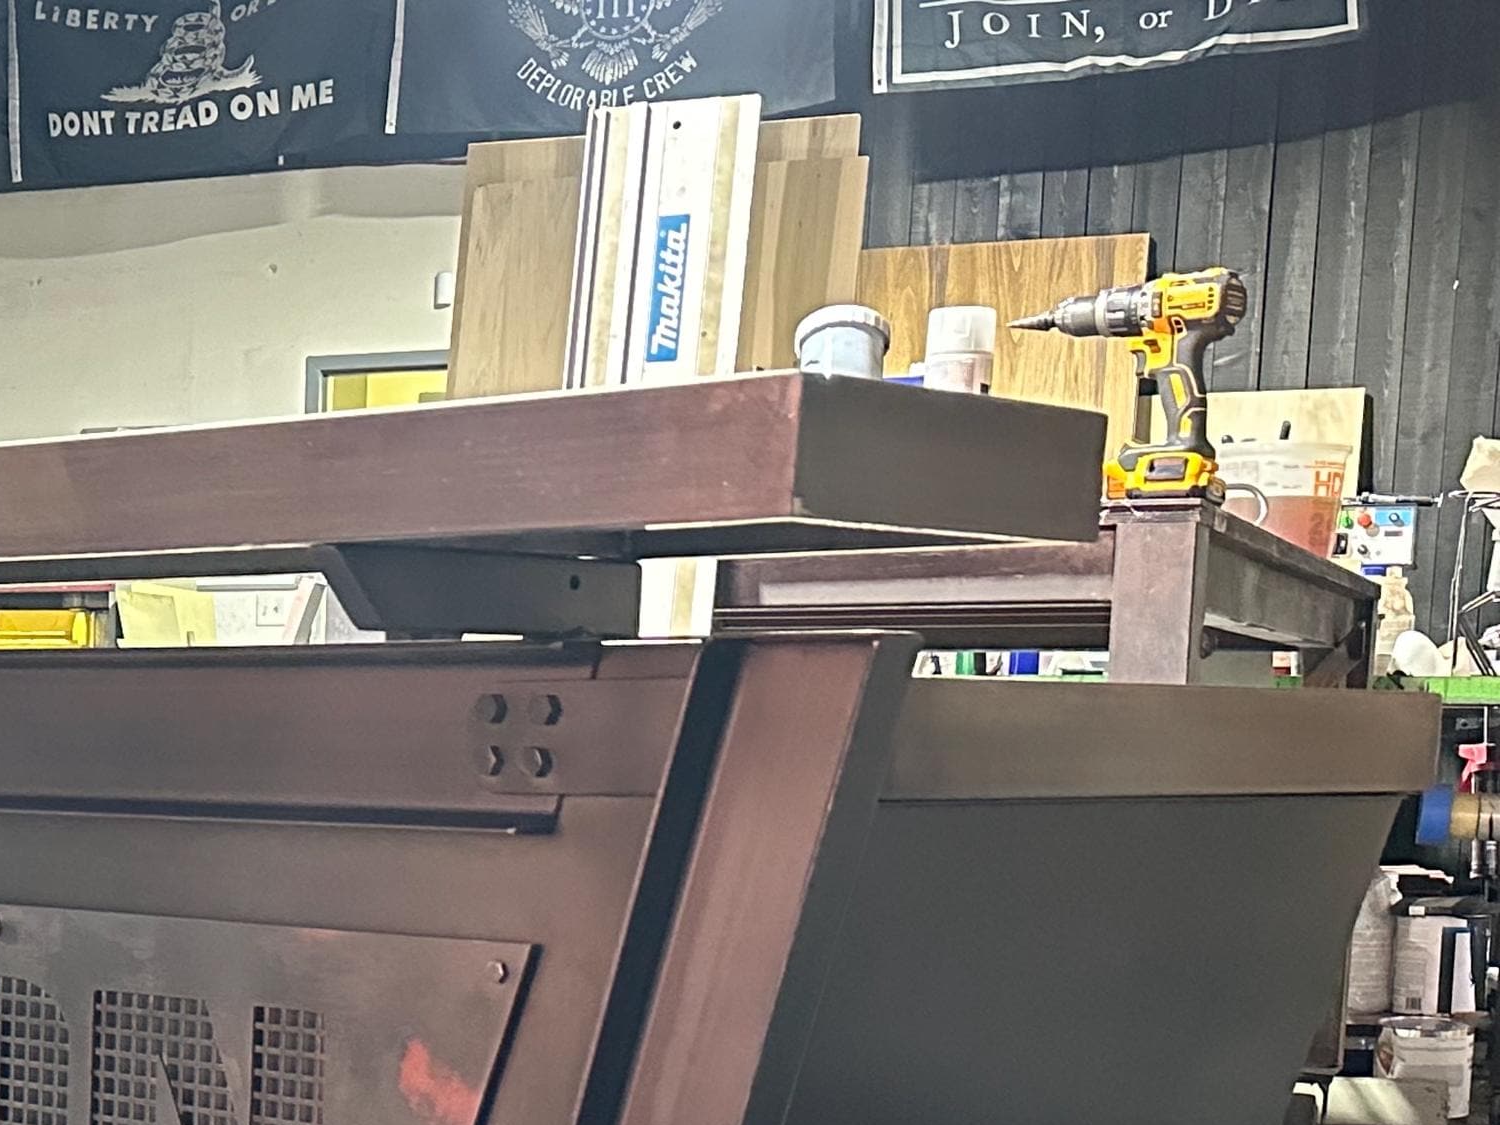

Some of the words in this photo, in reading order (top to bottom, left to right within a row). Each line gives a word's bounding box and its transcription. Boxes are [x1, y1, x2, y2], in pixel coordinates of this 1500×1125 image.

[35, 1, 159, 32] LIBERTY
[231, 0, 260, 21] OR
[944, 9, 1106, 49] JOIN,
[1139, 9, 1173, 30] or
[516, 57, 635, 111] DEPLORABLE
[642, 50, 698, 99] CREW
[48, 110, 116, 138] DONT
[125, 100, 219, 134] TREAD
[230, 89, 280, 121] ON
[291, 79, 334, 112] ME
